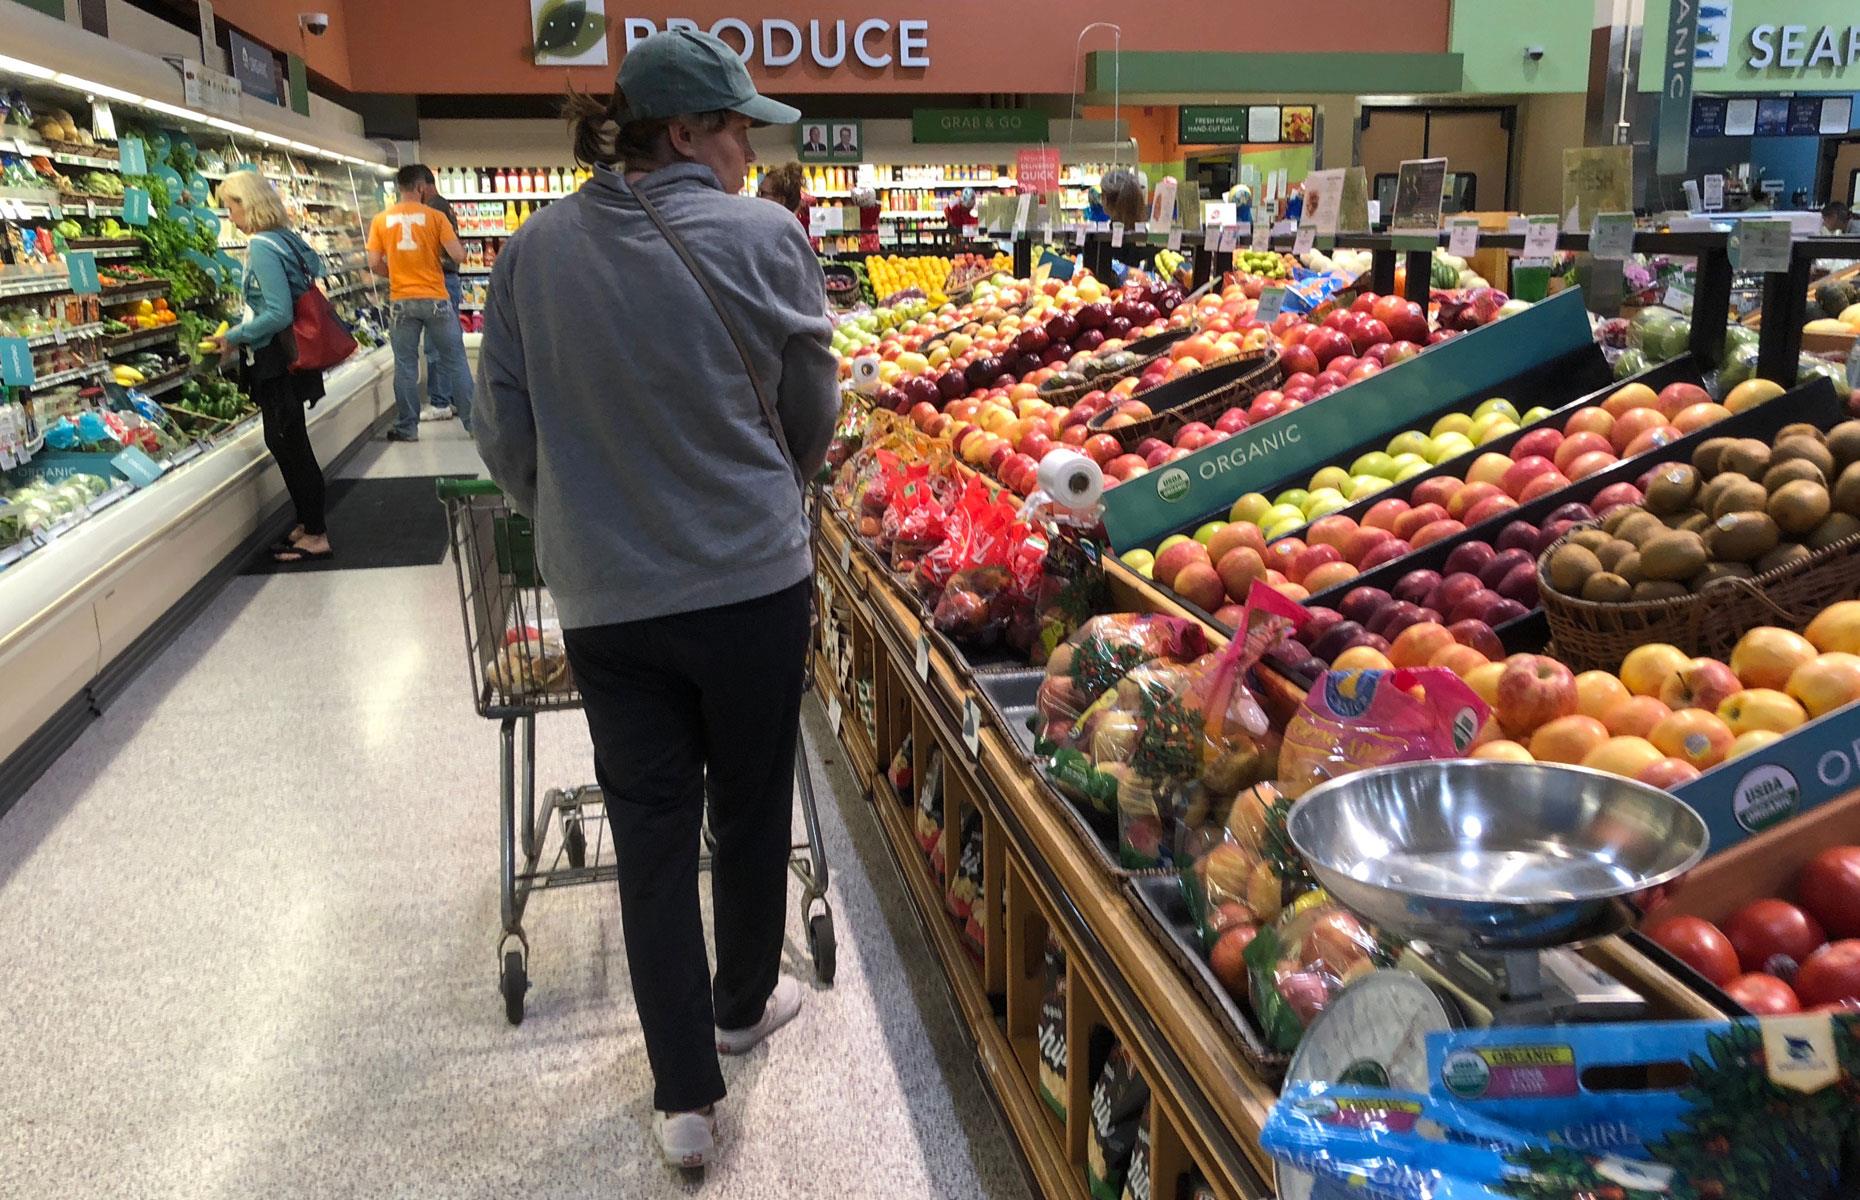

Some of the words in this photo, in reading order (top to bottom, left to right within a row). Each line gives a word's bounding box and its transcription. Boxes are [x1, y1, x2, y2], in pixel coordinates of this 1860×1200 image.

[625, 18, 930, 67] PODUCE
[941, 116, 981, 129] GRAB
[985, 117, 994, 128] &
[1000, 116, 1021, 129] GO
[1188, 125, 1221, 133] HAND-CUT
[1222, 125, 1240, 133] DAILY
[1020, 171, 1055, 180] QUICK
[386, 213, 426, 251] T
[1200, 423, 1302, 480] ORGANIC
[17, 466, 77, 478] ORGANIC
[1162, 472, 1183, 487] USDA
[1744, 776, 1784, 804] USDA
